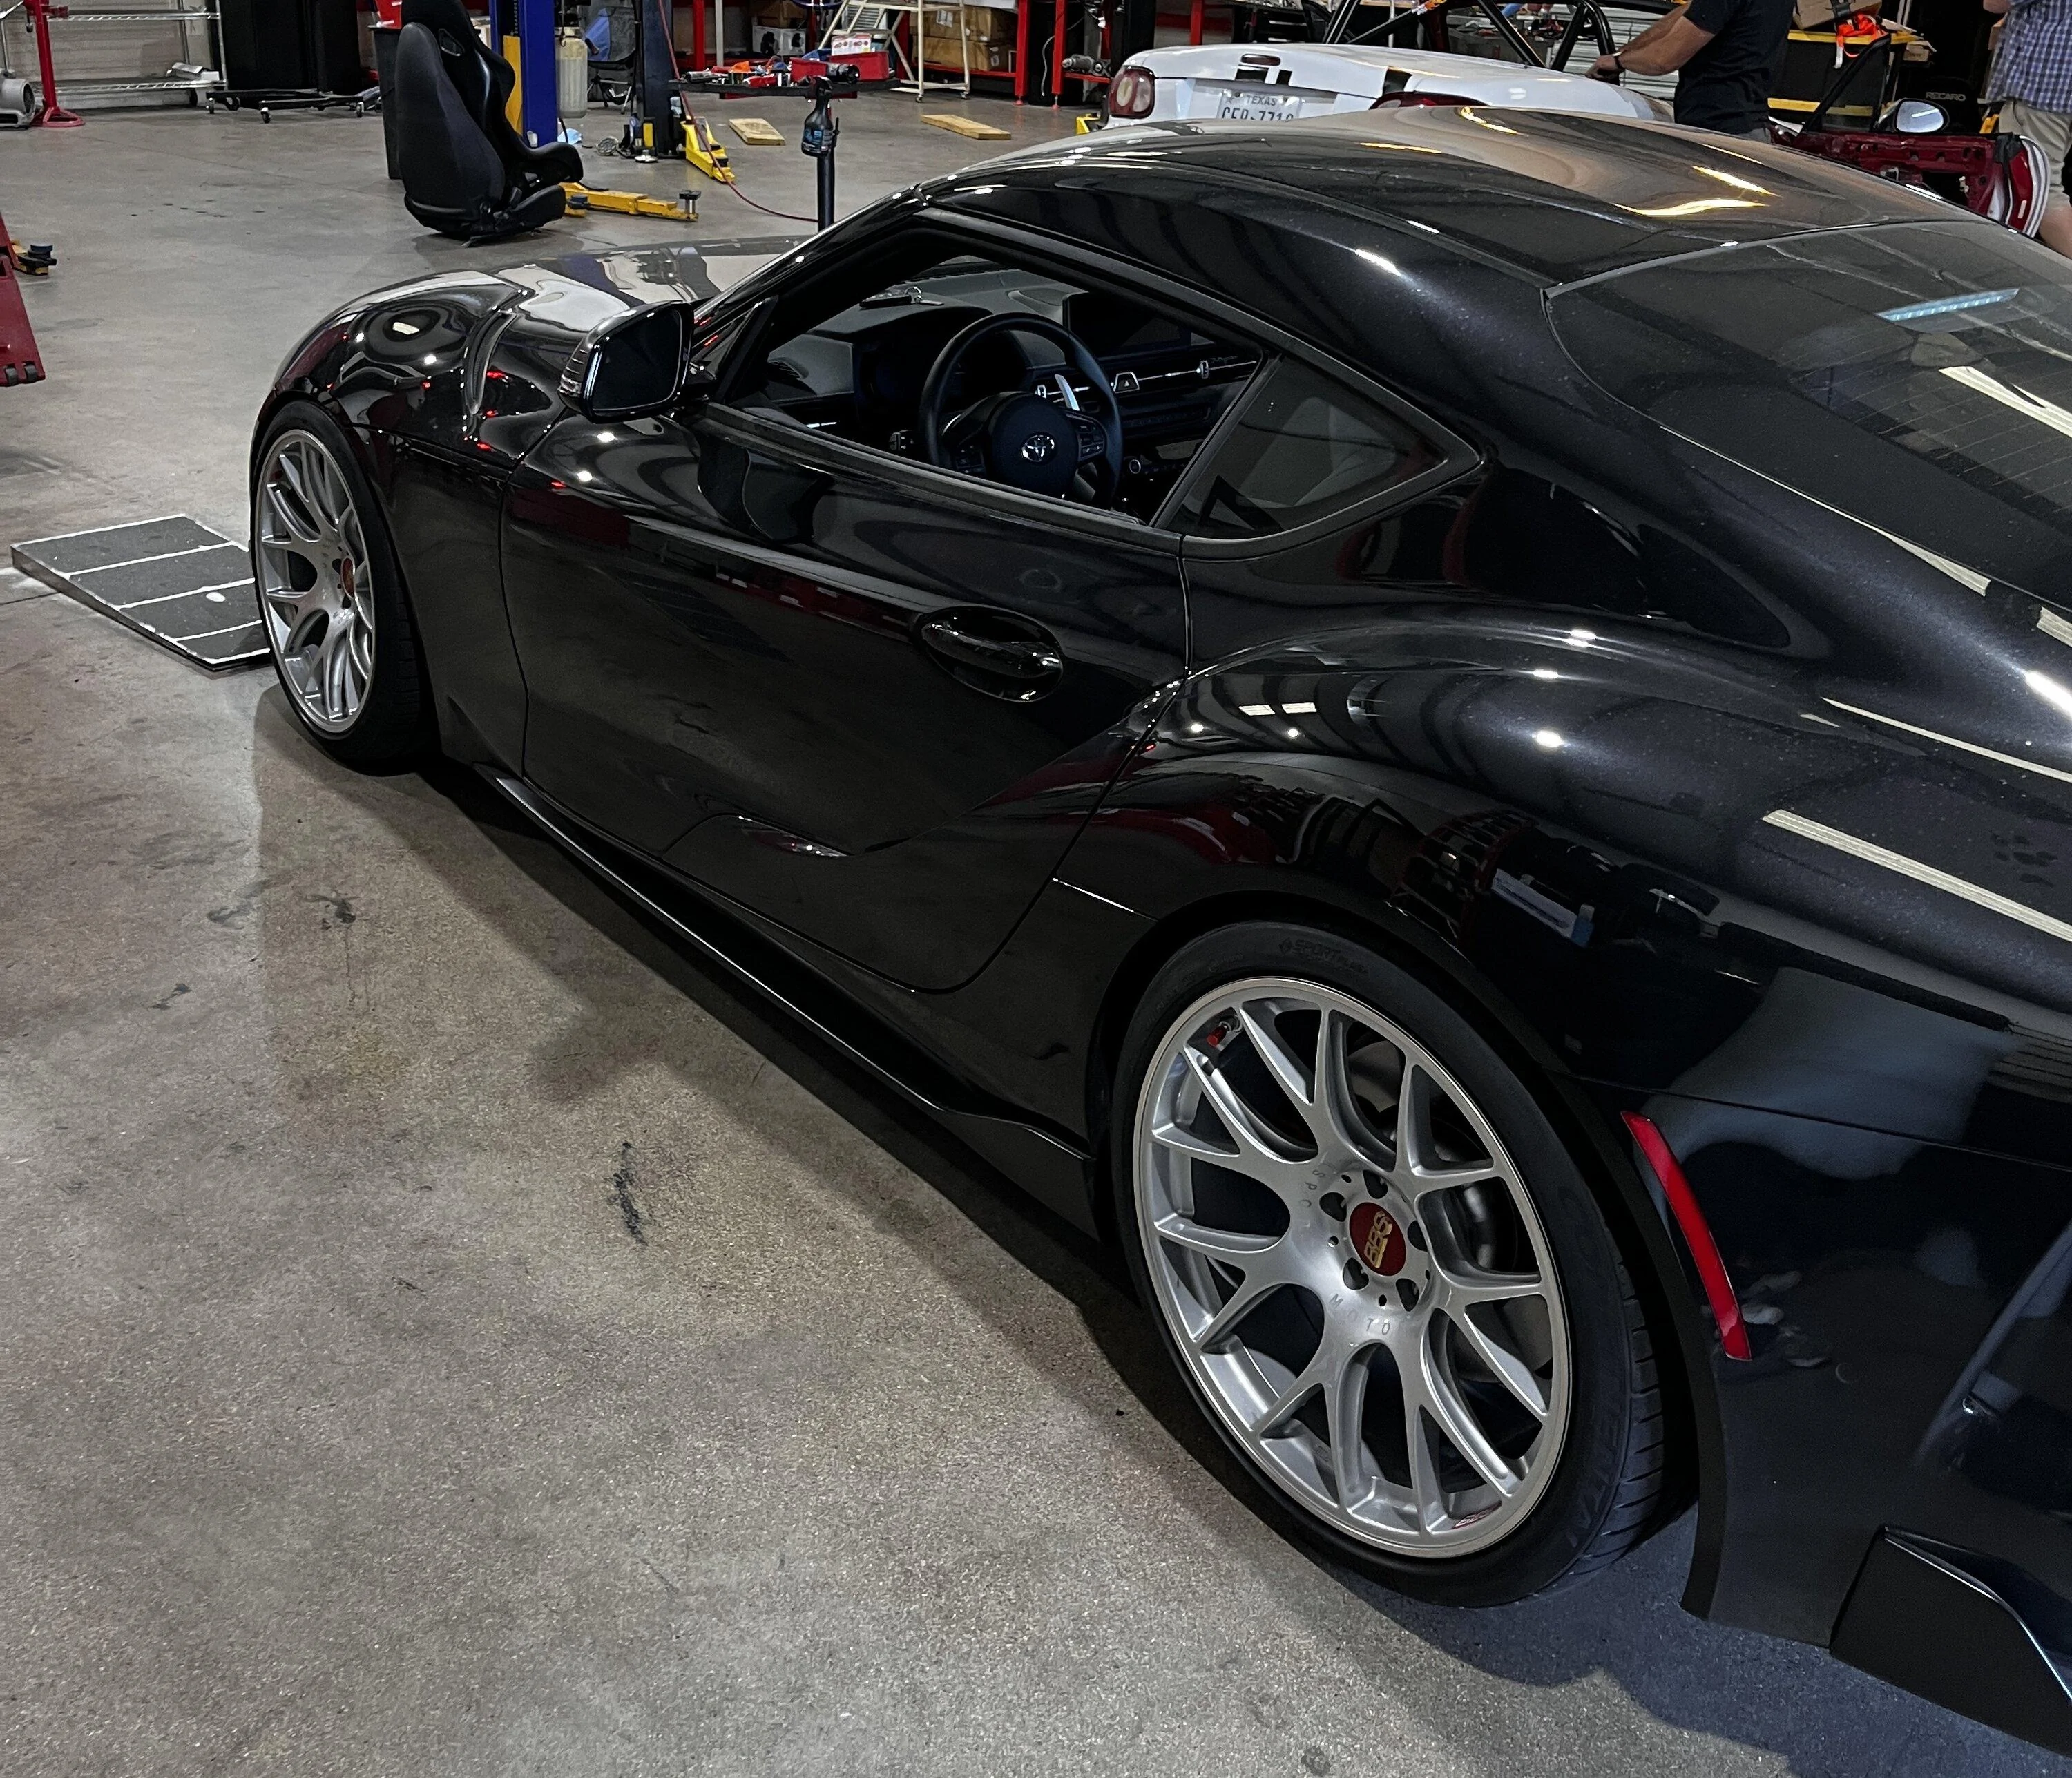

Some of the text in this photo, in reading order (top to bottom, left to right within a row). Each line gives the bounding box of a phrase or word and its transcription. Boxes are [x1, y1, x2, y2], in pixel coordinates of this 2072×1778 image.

[1246, 95, 1277, 106] TEXAS
[1925, 91, 1966, 102] RECARO
[1363, 1210, 1394, 1269] BBS
